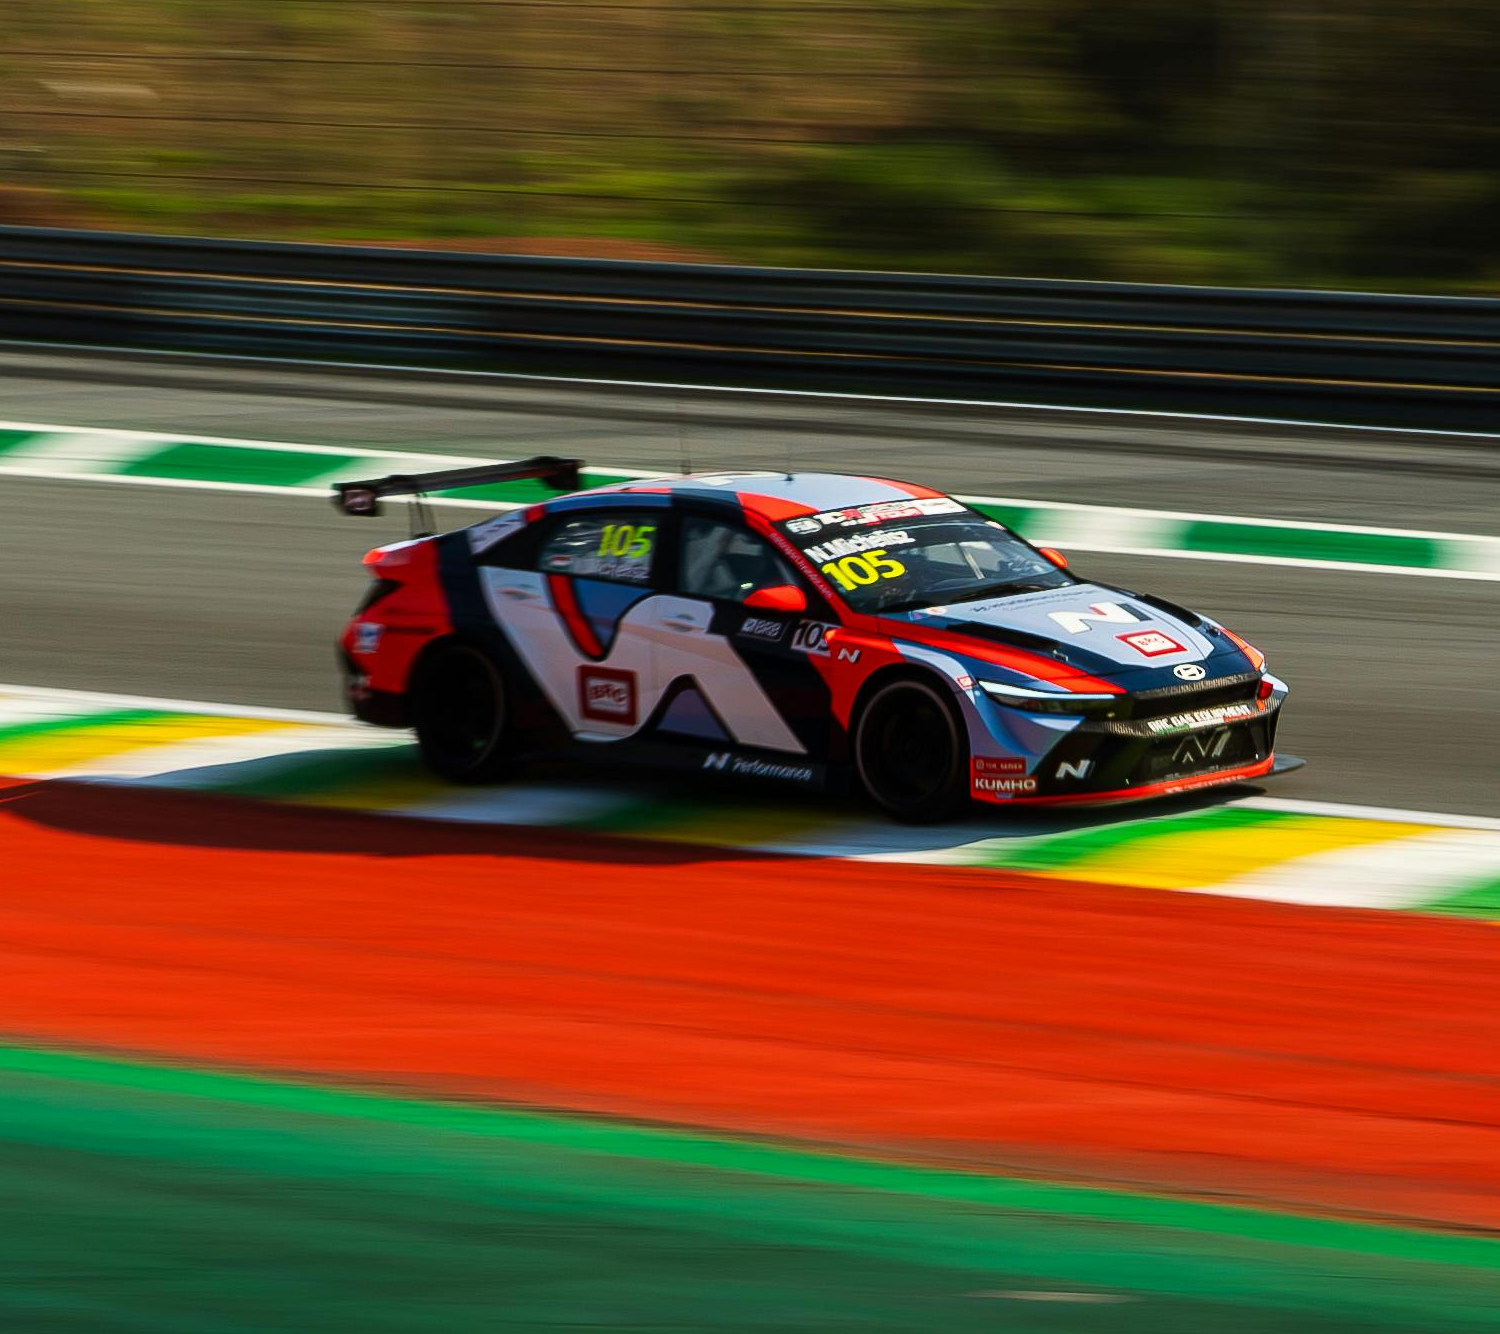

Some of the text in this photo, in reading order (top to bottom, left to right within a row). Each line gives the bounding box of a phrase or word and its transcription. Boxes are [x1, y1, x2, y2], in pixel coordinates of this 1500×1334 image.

[597, 524, 657, 558] 105
[821, 549, 906, 591] 105
[837, 648, 860, 664] N
[1056, 759, 1092, 779] N
[975, 778, 1036, 791] KUMHO
